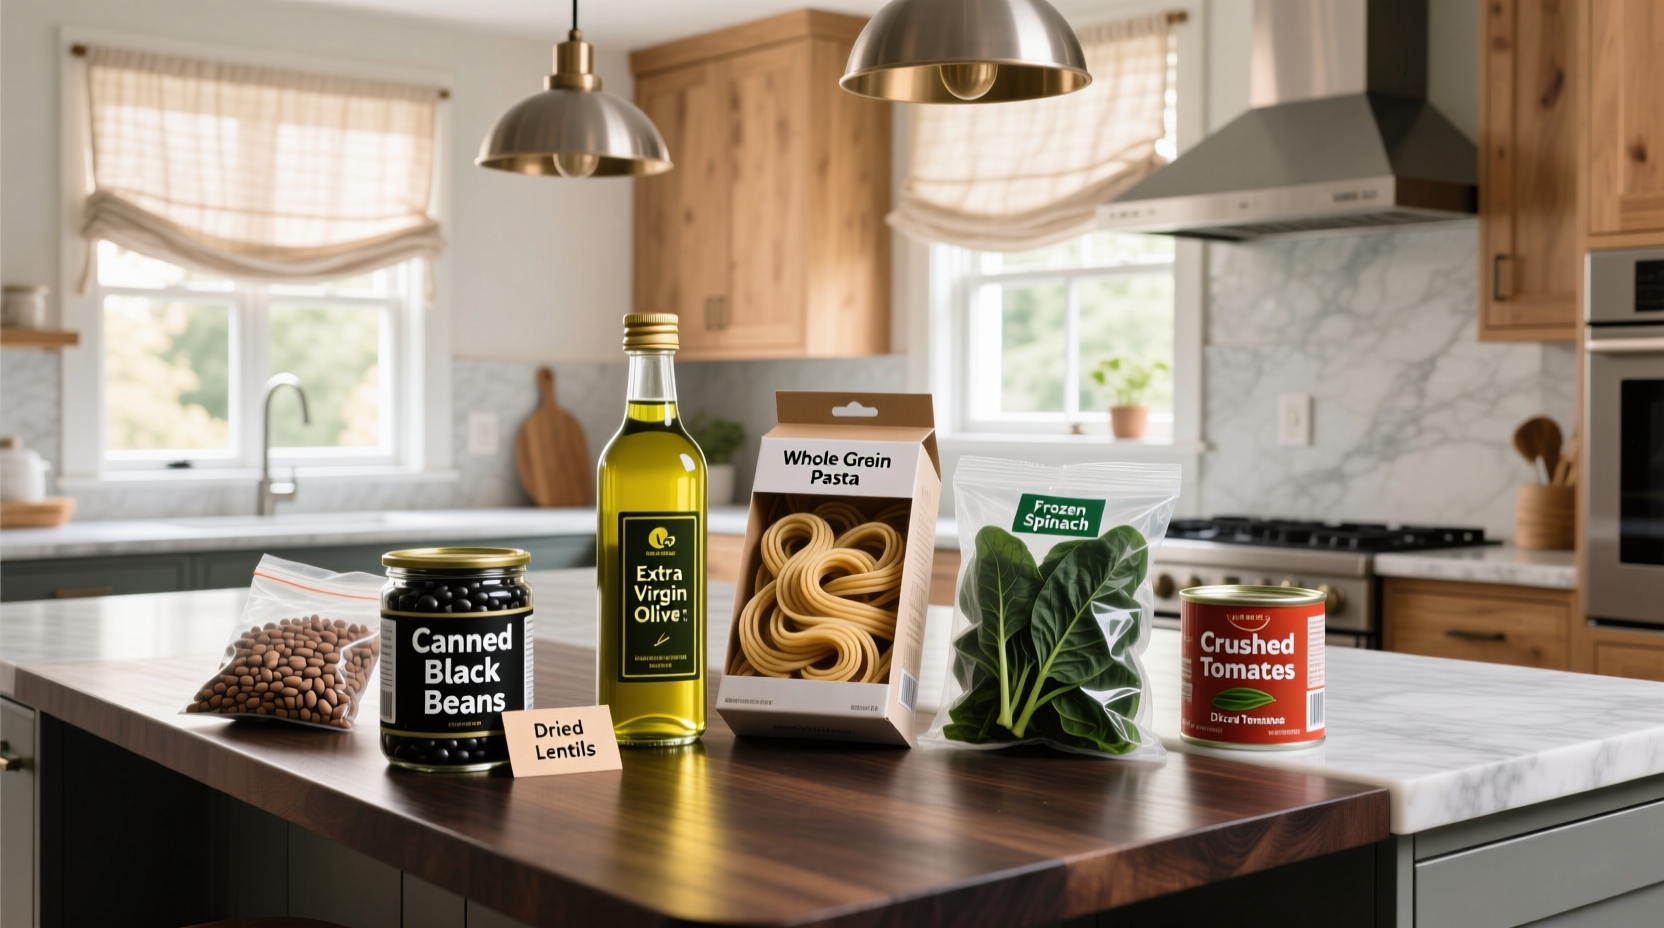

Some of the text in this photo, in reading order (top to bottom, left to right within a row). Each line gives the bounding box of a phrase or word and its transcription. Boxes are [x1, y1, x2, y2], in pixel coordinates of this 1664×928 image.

[783, 450, 839, 466] Whole
[810, 469, 860, 485] Pasta
[1034, 499, 1086, 517] Frozen
[1023, 513, 1089, 532] Spinach
[636, 565, 683, 582] Extra
[634, 584, 688, 606] Virgin
[412, 623, 513, 654] Canned
[1200, 630, 1295, 655] Crushed
[425, 656, 501, 685] Black
[1200, 656, 1296, 681] Tomates
[424, 689, 506, 715] Beans
[534, 719, 584, 739] Dried
[535, 740, 597, 760] Lentils
